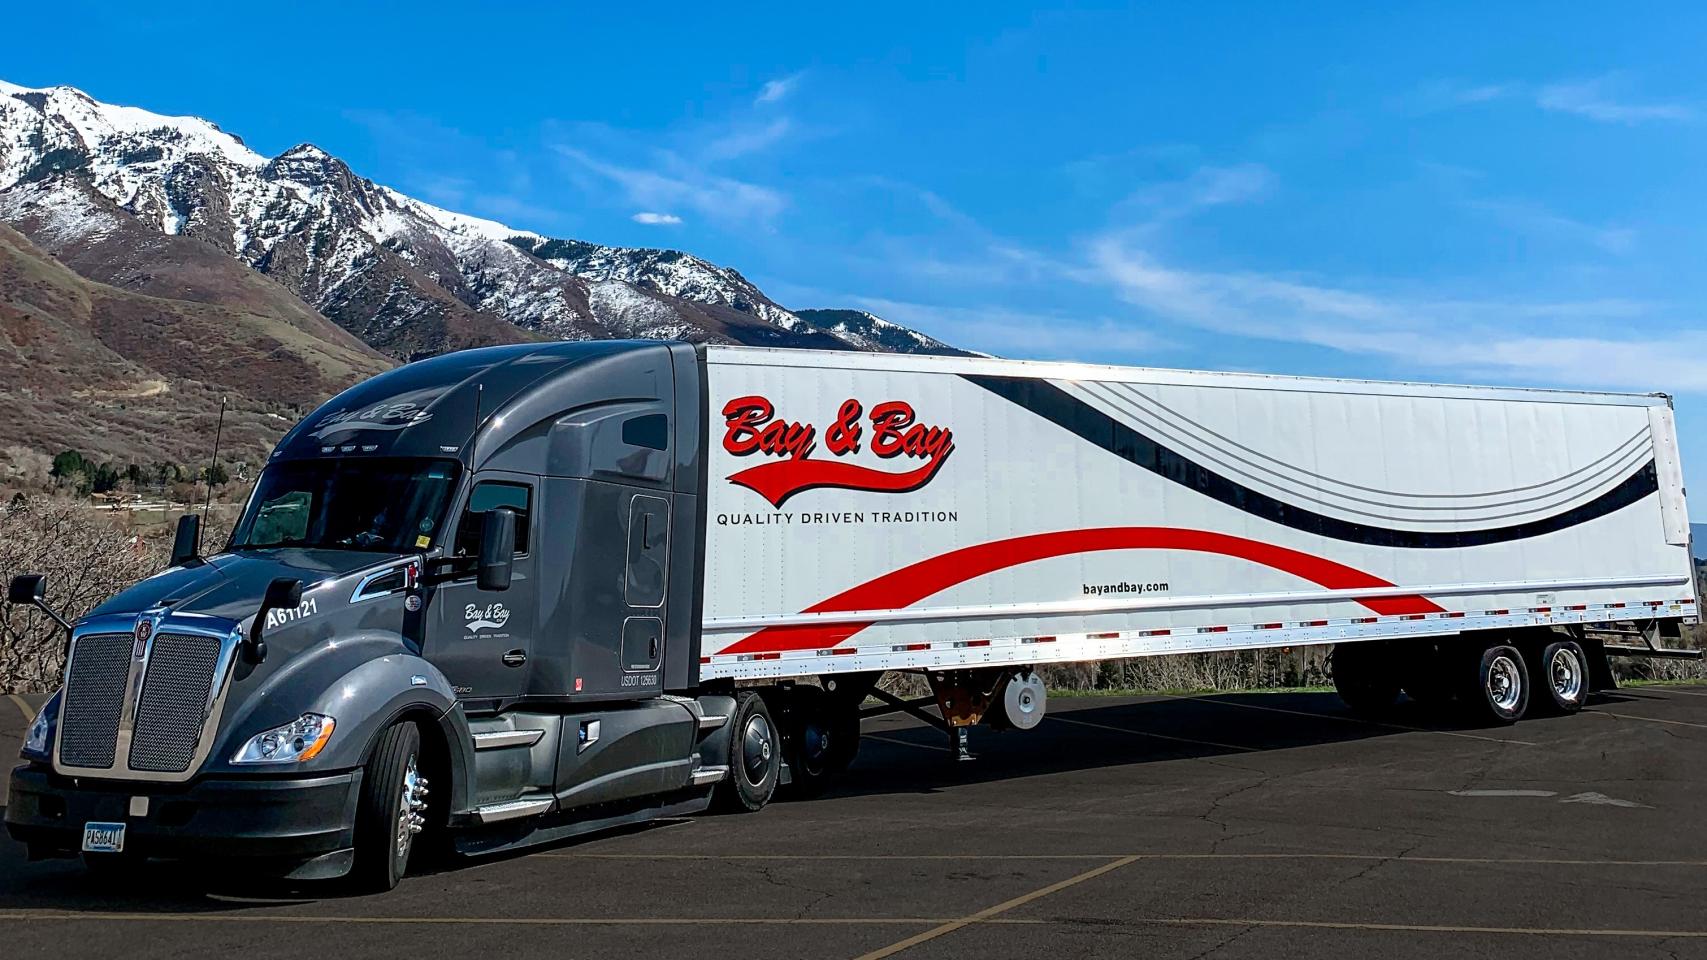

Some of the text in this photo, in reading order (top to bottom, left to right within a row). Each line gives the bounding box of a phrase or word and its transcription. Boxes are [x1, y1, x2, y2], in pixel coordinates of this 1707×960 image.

[360, 404, 388, 420] &
[382, 402, 434, 425] Bay
[722, 396, 956, 463] Bay & Bay
[717, 511, 959, 526] QUALITY DRIVEN TRADITION
[1082, 582, 1169, 596] bayandbay.com
[267, 597, 318, 630] A61121
[465, 603, 510, 620] Bay & Bay
[621, 675, 640, 687] USDOT
